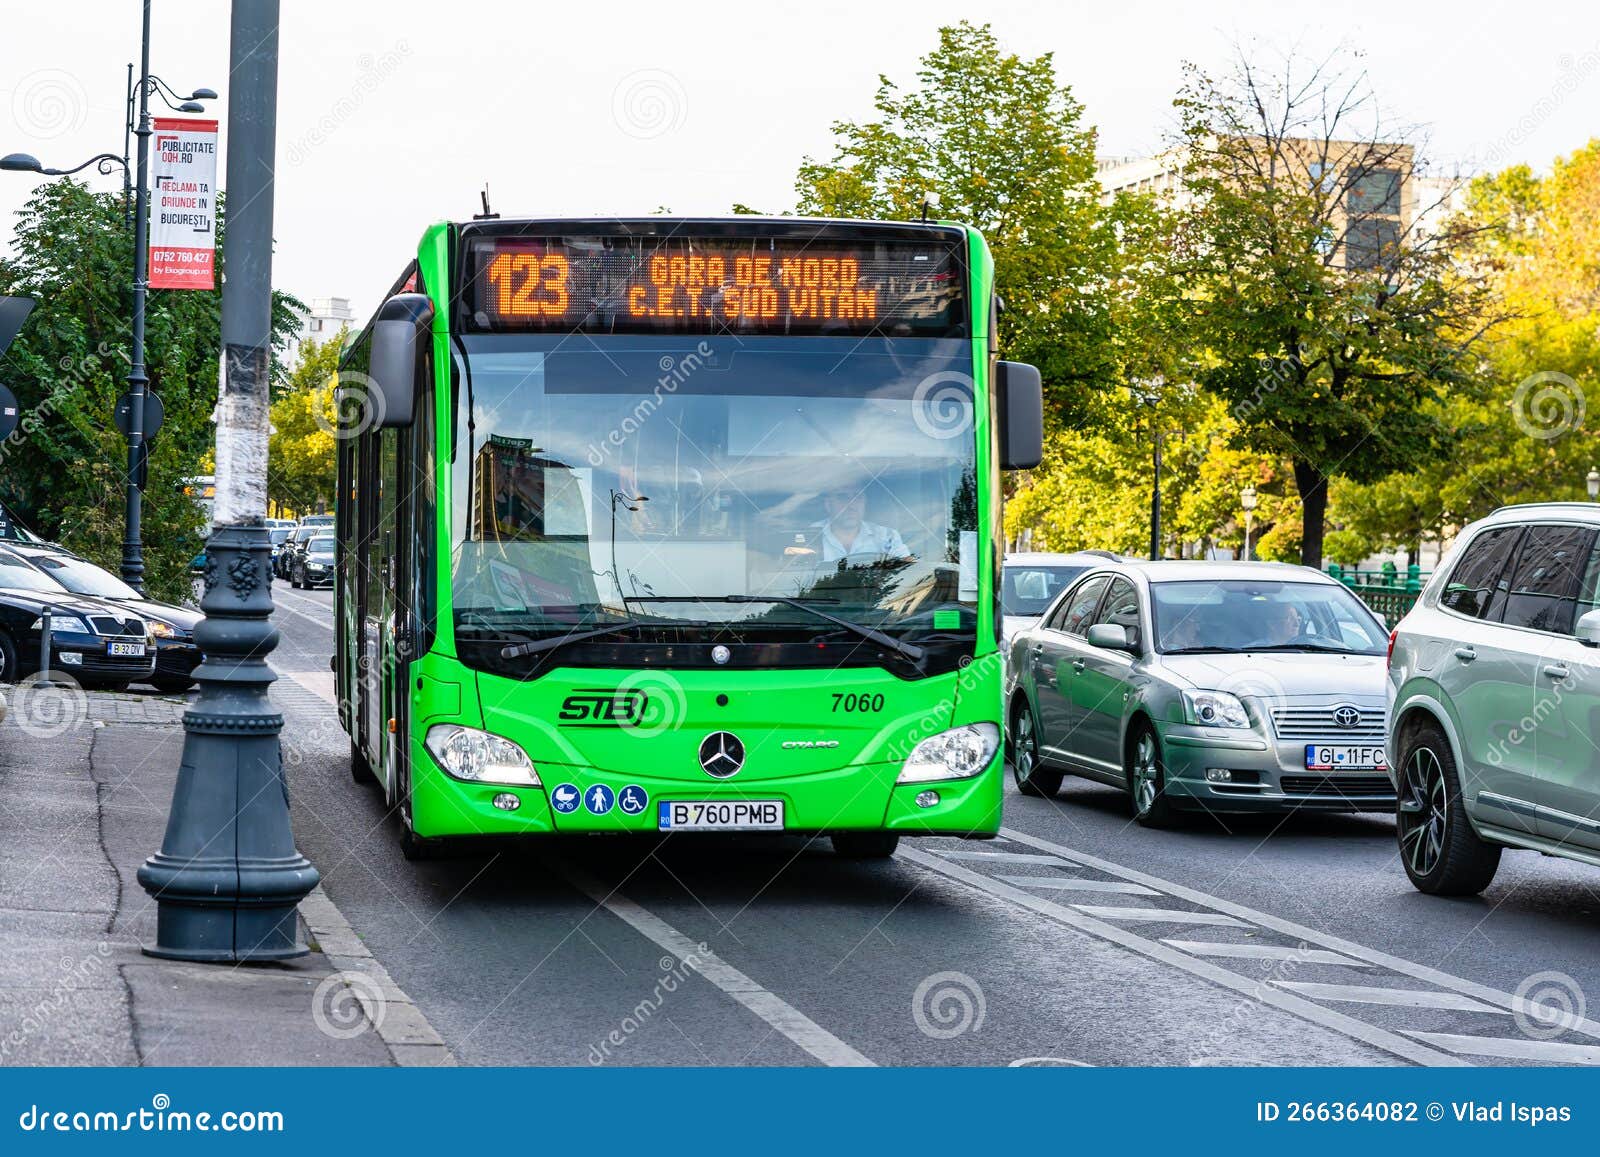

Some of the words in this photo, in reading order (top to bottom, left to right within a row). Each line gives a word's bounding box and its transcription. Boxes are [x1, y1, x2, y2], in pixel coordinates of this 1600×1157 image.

[162, 141, 214, 154] PUBLICITATE
[162, 182, 198, 193] RECLAMA
[200, 183, 209, 193] TA
[161, 196, 197, 208] ORIUNDE
[198, 198, 207, 209] IN
[153, 251, 175, 262] 0752
[176, 251, 193, 263] 760
[193, 252, 210, 263] 427
[153, 266, 164, 275] by
[650, 256, 725, 287] GARA
[736, 257, 772, 287] DE
[781, 258, 859, 288] NORD
[489, 253, 569, 315] 123
[628, 284, 713, 318] C.E.T.
[723, 288, 778, 318] SUD
[788, 289, 877, 319] VITAN
[831, 693, 885, 713] 7060
[781, 740, 840, 750] CITARO
[1319, 748, 1341, 764] GL
[1346, 748, 1358, 764] 11
[674, 805, 689, 825] B
[693, 805, 731, 824] 760
[734, 804, 778, 824] PMB
